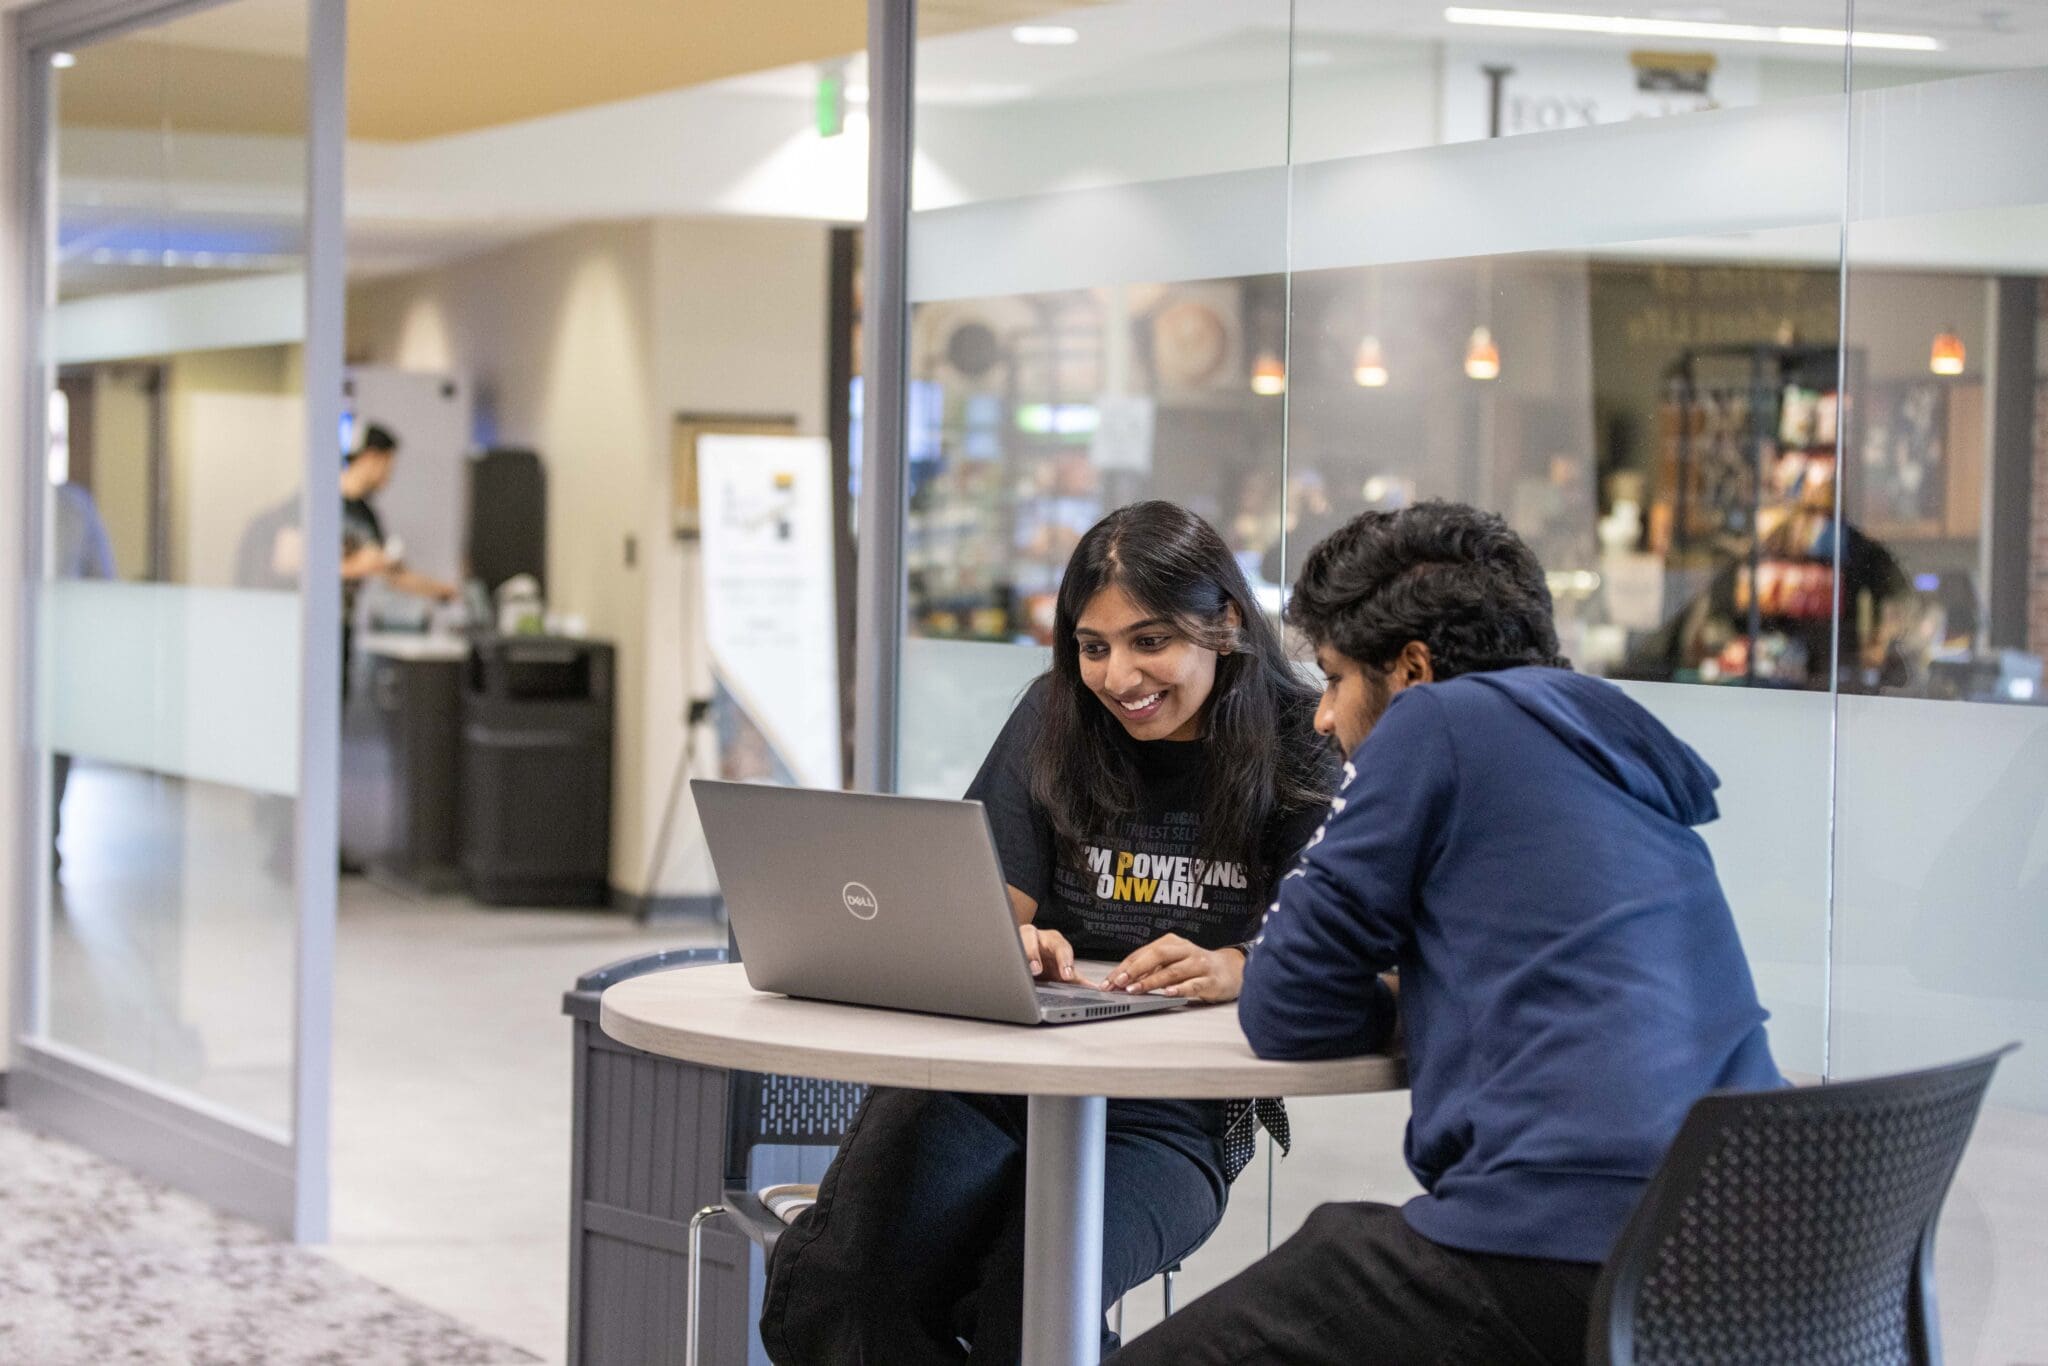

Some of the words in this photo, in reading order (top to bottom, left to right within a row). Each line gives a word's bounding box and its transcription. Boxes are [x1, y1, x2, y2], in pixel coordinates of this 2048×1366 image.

[1172, 827, 1202, 842] SELF
[1116, 852, 1247, 889] POWERING
[1096, 873, 1209, 910] ONWARD.
[846, 894, 875, 908] DELL
[1095, 901, 1123, 912] ACTIVE
[1123, 904, 1171, 916] COMMUNITY
[1107, 912, 1153, 926] EXCELLENCE
